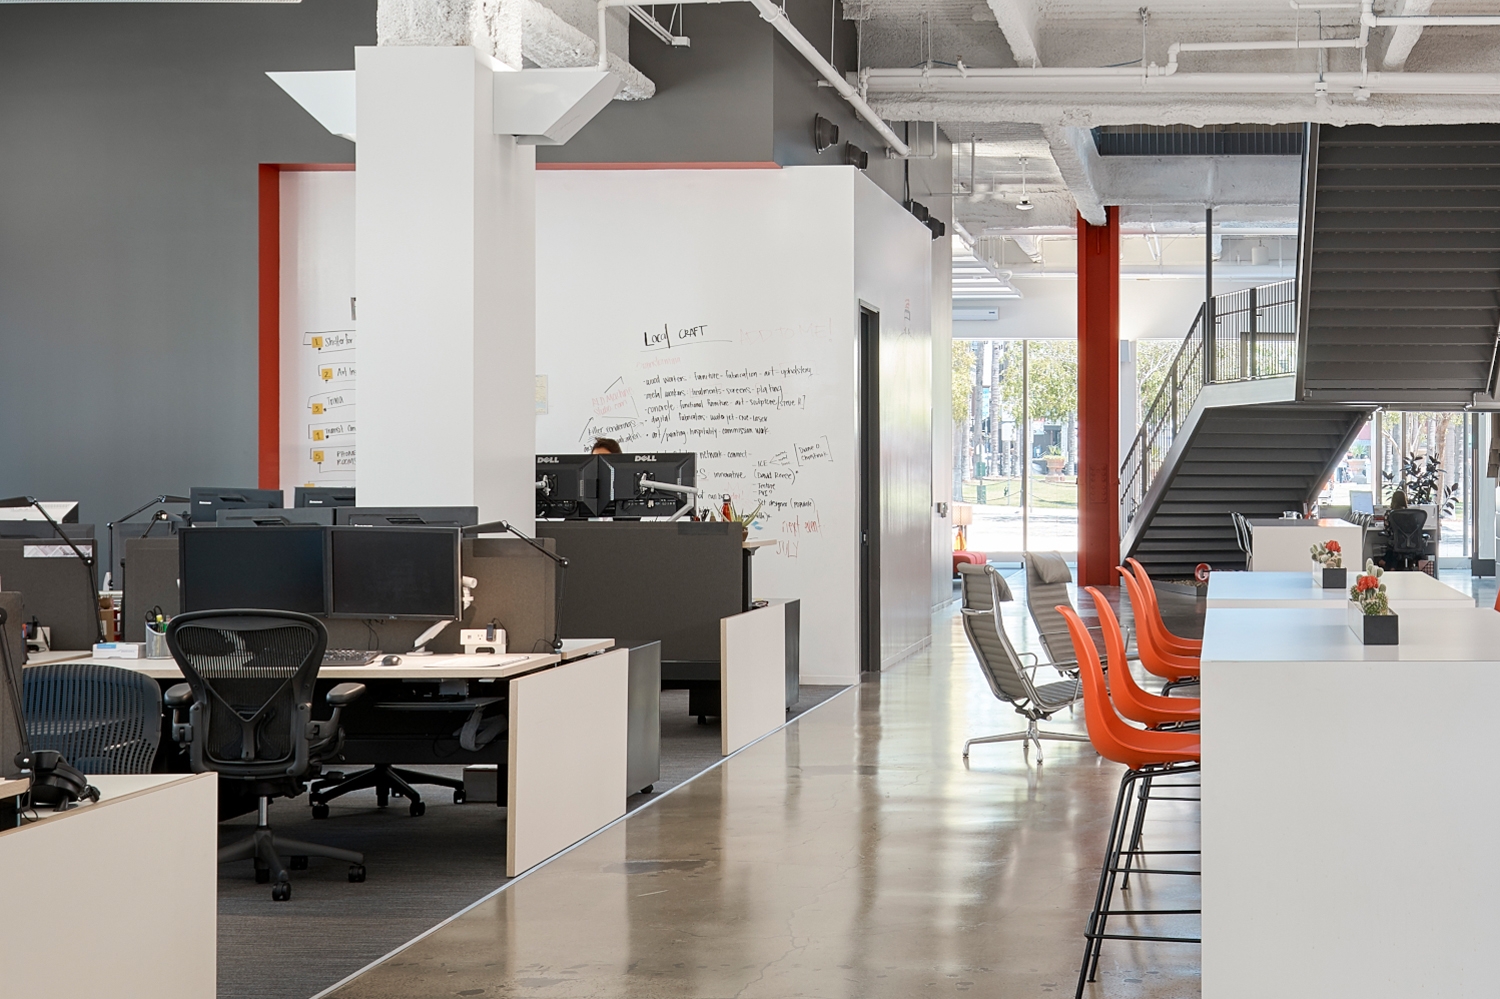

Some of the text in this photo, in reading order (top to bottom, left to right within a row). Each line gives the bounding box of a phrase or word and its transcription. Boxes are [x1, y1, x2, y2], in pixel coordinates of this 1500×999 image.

[678, 325, 708, 339] CRAFT
[537, 456, 559, 464] DELL
[634, 454, 657, 462] DELL
